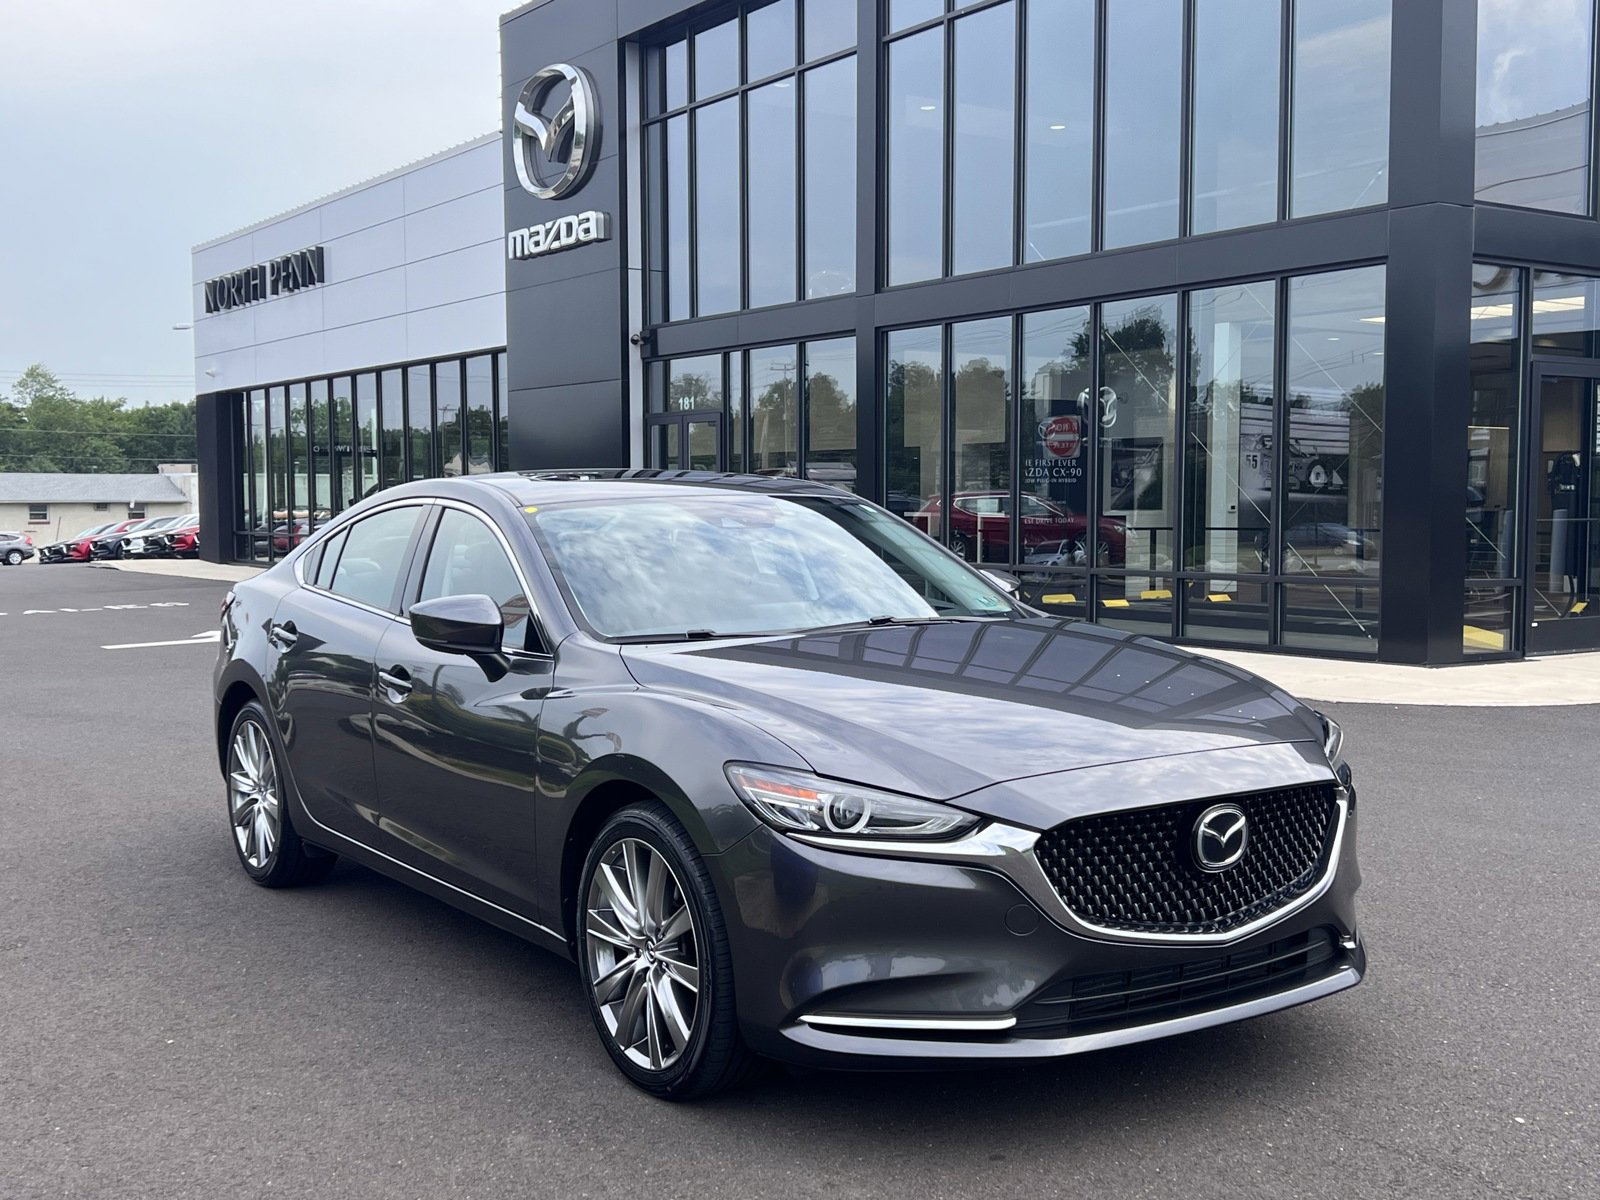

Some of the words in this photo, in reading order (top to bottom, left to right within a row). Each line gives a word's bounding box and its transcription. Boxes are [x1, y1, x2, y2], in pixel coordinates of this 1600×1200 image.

[204, 263, 267, 314] NORTH
[269, 246, 325, 296] PENN
[678, 396, 695, 411] 181
[1035, 459, 1055, 467] FIRST
[1058, 459, 1077, 467] EVER
[1052, 467, 1082, 477] CX-90
